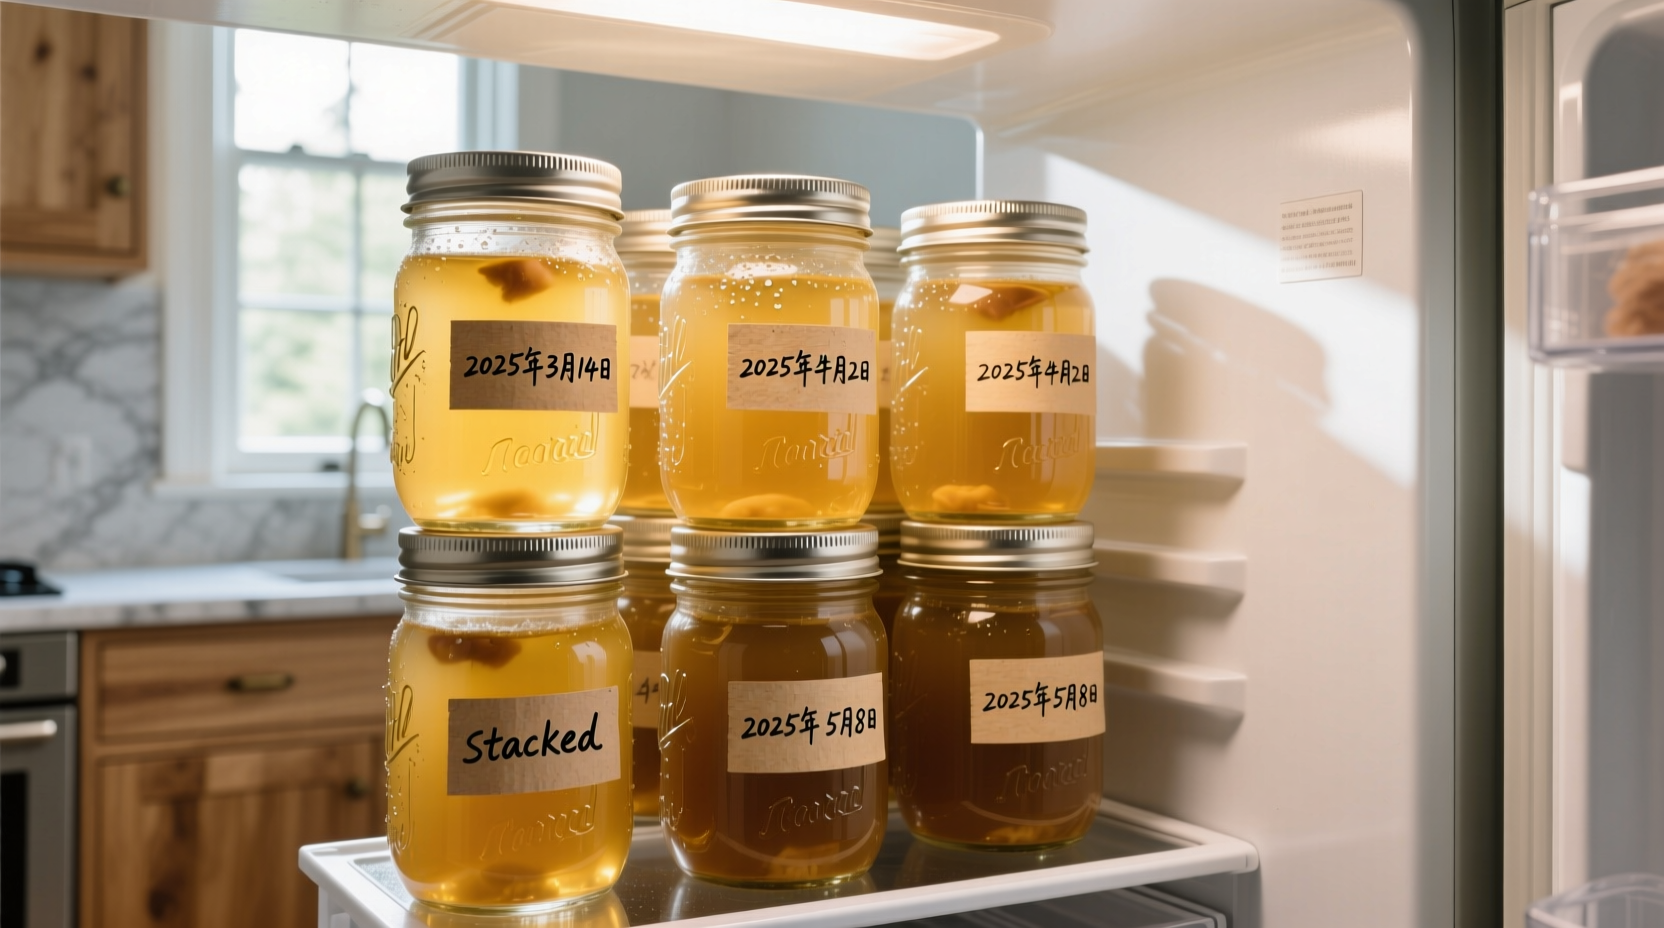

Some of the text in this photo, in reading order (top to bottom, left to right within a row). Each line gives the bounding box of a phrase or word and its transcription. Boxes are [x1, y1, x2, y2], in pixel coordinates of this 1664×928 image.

[463, 346, 611, 387] 2025年3月14日
[982, 681, 1098, 718] 2025年5月8日
[461, 711, 604, 765] Stacked
